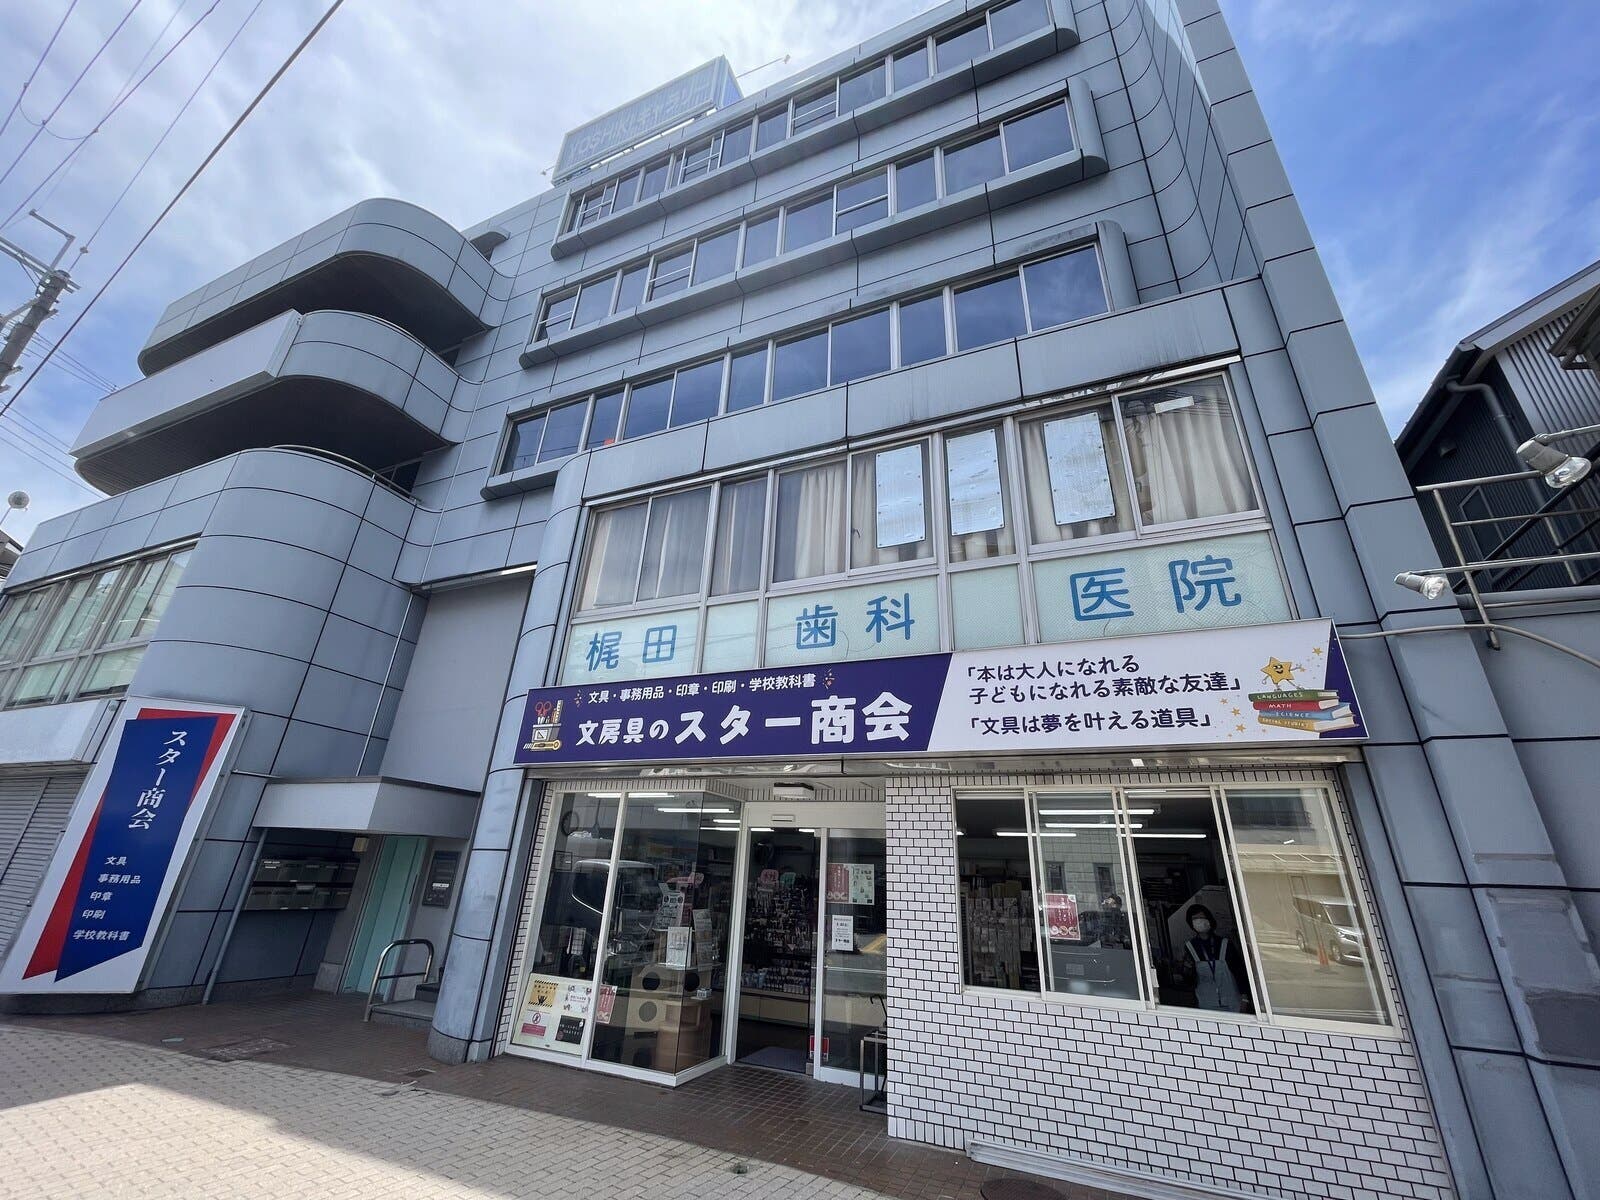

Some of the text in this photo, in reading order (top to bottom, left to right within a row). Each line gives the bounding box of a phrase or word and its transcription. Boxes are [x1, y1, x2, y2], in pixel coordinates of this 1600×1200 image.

[585, 554, 1242, 672] 梶田 歯科 医院
[967, 654, 1140, 683] 「本は大人になれる
[587, 672, 817, 704] 文具・事務用品・印章・印刷・学校教科書
[969, 671, 1241, 705] 子どもになれる素敵な友達」
[1257, 692, 1303, 700] LANGUAGES
[575, 690, 913, 747] 文房具のスター商会
[971, 707, 1211, 735] 「文具は夢を叶える道具」
[128, 731, 187, 829] スター商会
[104, 856, 127, 866] 文具
[97, 873, 141, 884] 事務用品
[89, 891, 113, 901] 印章
[81, 909, 106, 920] 印刷
[72, 929, 131, 941] 学校教科書
